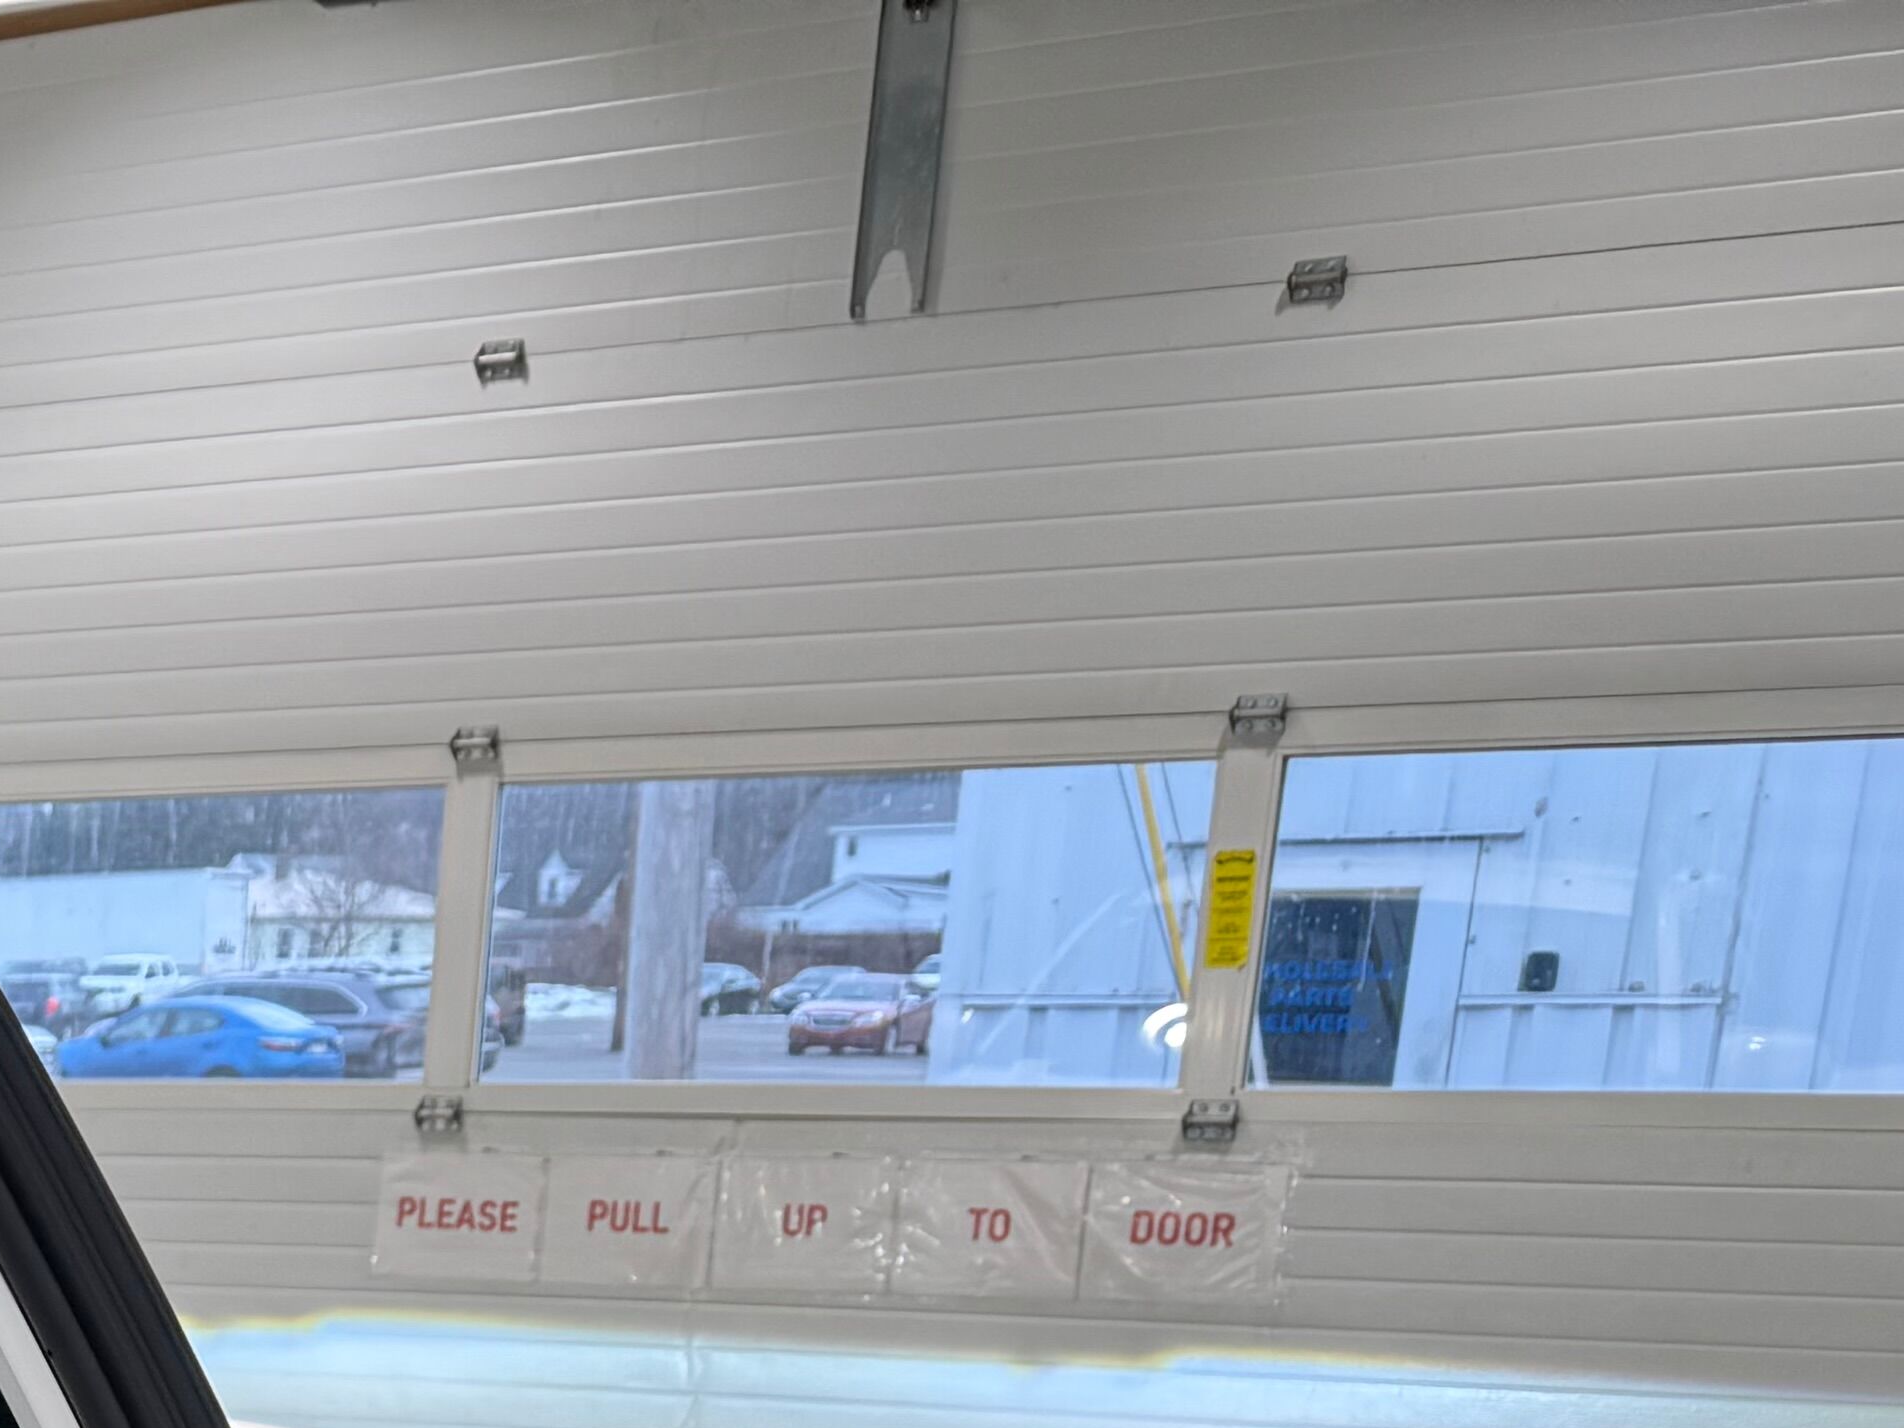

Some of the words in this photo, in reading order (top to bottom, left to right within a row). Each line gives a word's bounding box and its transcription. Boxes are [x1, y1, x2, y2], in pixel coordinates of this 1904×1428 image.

[395, 1196, 520, 1232] PLEASE
[587, 1199, 670, 1234] PULL
[782, 1203, 829, 1237] UP
[968, 1207, 1012, 1243] TO
[1129, 1210, 1237, 1248] DOOR
